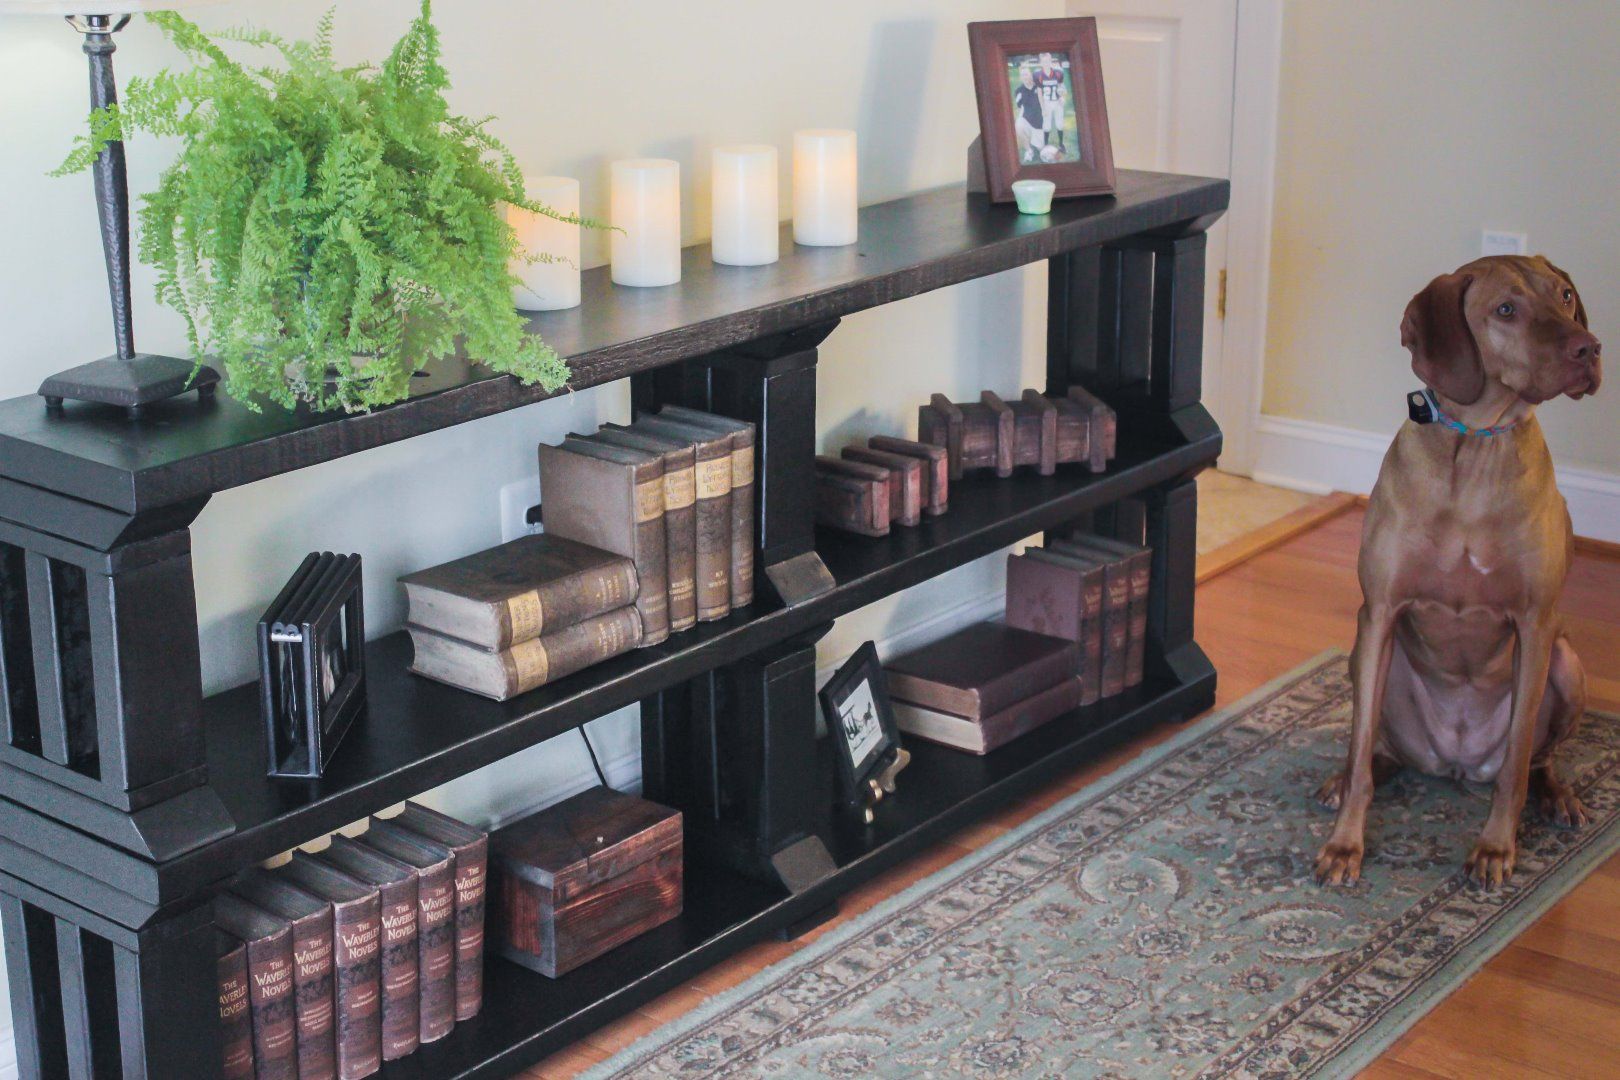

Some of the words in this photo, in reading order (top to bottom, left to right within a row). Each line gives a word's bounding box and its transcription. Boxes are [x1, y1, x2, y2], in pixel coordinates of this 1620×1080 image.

[467, 867, 480, 876] THE
[396, 904, 410, 913] THE
[357, 922, 370, 932] THE
[387, 922, 416, 940] NOVELS
[342, 925, 380, 948] WAVERLEY
[309, 939, 322, 949] THE
[349, 940, 378, 959] NOVELS
[269, 960, 284, 970] THE
[301, 959, 330, 977] NOVELS
[223, 980, 238, 991] THE
[262, 978, 292, 998] NOVELS
[220, 983, 247, 1005] AVERLE
